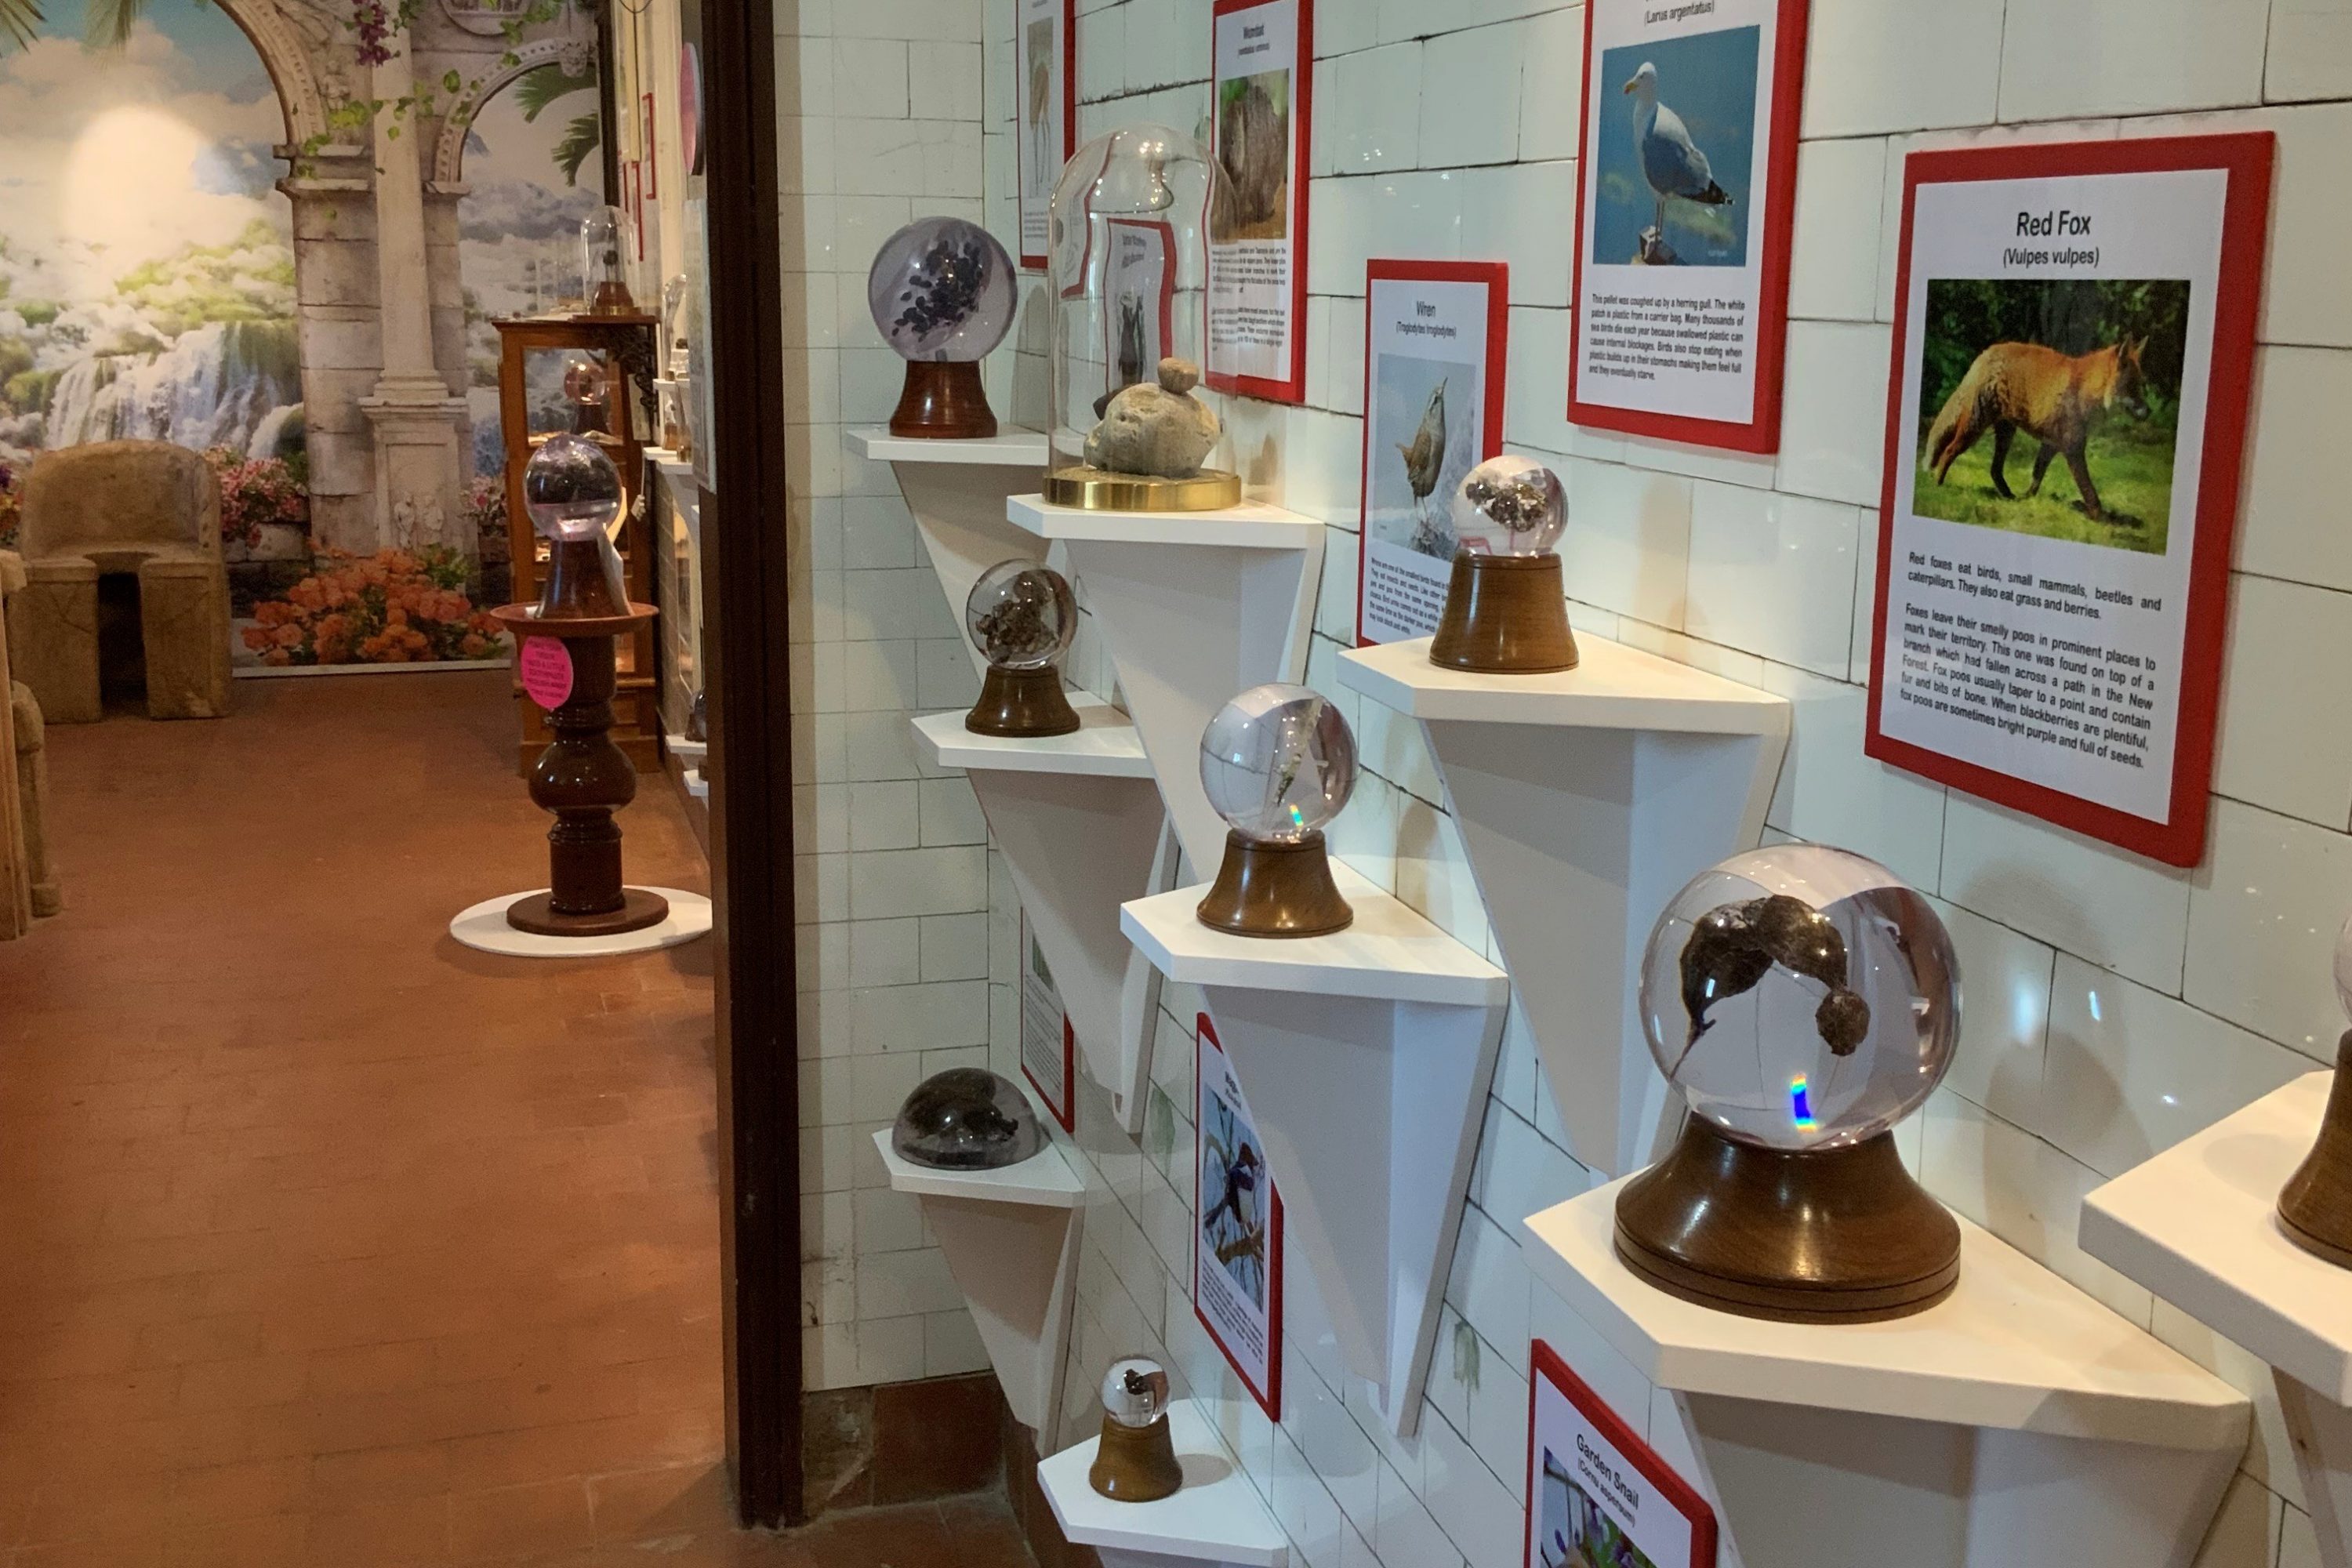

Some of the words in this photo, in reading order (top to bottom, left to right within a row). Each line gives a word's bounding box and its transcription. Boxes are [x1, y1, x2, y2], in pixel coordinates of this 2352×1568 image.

[1644, 11, 1668, 27] (Larus
[1669, 0, 1715, 21] argentatus)
[2003, 249, 2049, 268] (Vulpes
[2052, 246, 2100, 267] vulpes)
[2016, 211, 2052, 237] Red
[2058, 210, 2092, 236] Fox
[1417, 300, 1436, 318] Wren
[1907, 571, 1955, 590] caterpillars.
[1958, 578, 1978, 597] They
[1980, 584, 1998, 598] also
[1999, 589, 2014, 602] eat
[2015, 593, 2042, 608] grass
[2043, 598, 2062, 612] and
[2063, 599, 2100, 619] berries.
[1908, 551, 1926, 565] Red
[1929, 554, 1952, 571] foxes
[1958, 563, 1972, 575] eat
[1976, 564, 2001, 583] birds,
[2007, 573, 2033, 586] small
[2038, 579, 2086, 599] mammals,
[2094, 586, 2133, 606] beetles
[2140, 597, 2161, 612] and
[1904, 622, 1925, 636] mark
[1928, 626, 1947, 641] their
[1951, 631, 1987, 654] territory.
[1992, 640, 2011, 657] This
[2013, 648, 2032, 662] one
[2035, 654, 2055, 667] was
[2059, 655, 2087, 675] found
[2091, 666, 2104, 678] on
[2109, 668, 2126, 686] top
[2130, 674, 2142, 688] of
[2147, 680, 2154, 691] a
[1905, 602, 1929, 619] Foxes
[1931, 608, 1954, 625] leave
[1956, 614, 1977, 630] their
[1980, 622, 2009, 640] smelly
[2012, 630, 2035, 644] poos
[2038, 635, 2048, 646] in
[2051, 638, 2102, 659] prominent
[2105, 648, 2140, 668] places
[2145, 656, 2156, 671] to
[1902, 653, 1928, 672] Forest.
[1933, 662, 1947, 677] Fox
[1949, 669, 1971, 683] poos
[1973, 676, 2005, 695] usually
[2008, 681, 2033, 699] taper
[2036, 689, 2046, 703] to
[2049, 695, 2056, 706] a
[2059, 698, 2085, 713] point
[2088, 705, 2108, 719] and
[2111, 711, 2151, 730] contain
[1903, 637, 1931, 655] branch
[1935, 646, 1960, 662] which
[1964, 652, 1981, 668] had
[1985, 657, 2010, 674] fallen
[2014, 667, 2046, 684] across
[2051, 677, 2058, 687] a
[2063, 679, 2085, 694] path
[2091, 683, 2100, 698] in
[2106, 687, 2123, 703] the
[2129, 692, 2153, 710] New
[1900, 687, 1912, 701] fox
[1912, 694, 1933, 708] poos
[1934, 700, 1948, 713] are
[1949, 704, 1996, 726] sometimes
[1997, 715, 2025, 735] bright
[2026, 726, 2057, 744] purple
[2058, 735, 2078, 750] and
[2079, 738, 2095, 754] full
[2096, 745, 2108, 757] of
[2110, 750, 2143, 768] seeds.
[1901, 670, 1912, 684] fur
[1915, 677, 1931, 690] and
[1933, 680, 1949, 695] bits
[1951, 686, 1961, 698] of
[1963, 688, 1987, 706] bone.
[1991, 695, 2016, 713] When
[2019, 702, 2079, 731] blackberries
[2082, 723, 2100, 736] are
[2103, 727, 2148, 752] plentiful,
[1577, 1433, 1612, 1481] Garden
[1613, 1472, 1639, 1510] Snail
[1577, 1457, 1599, 1490] (Cornu
[1600, 1486, 1635, 1528] aspersum)
